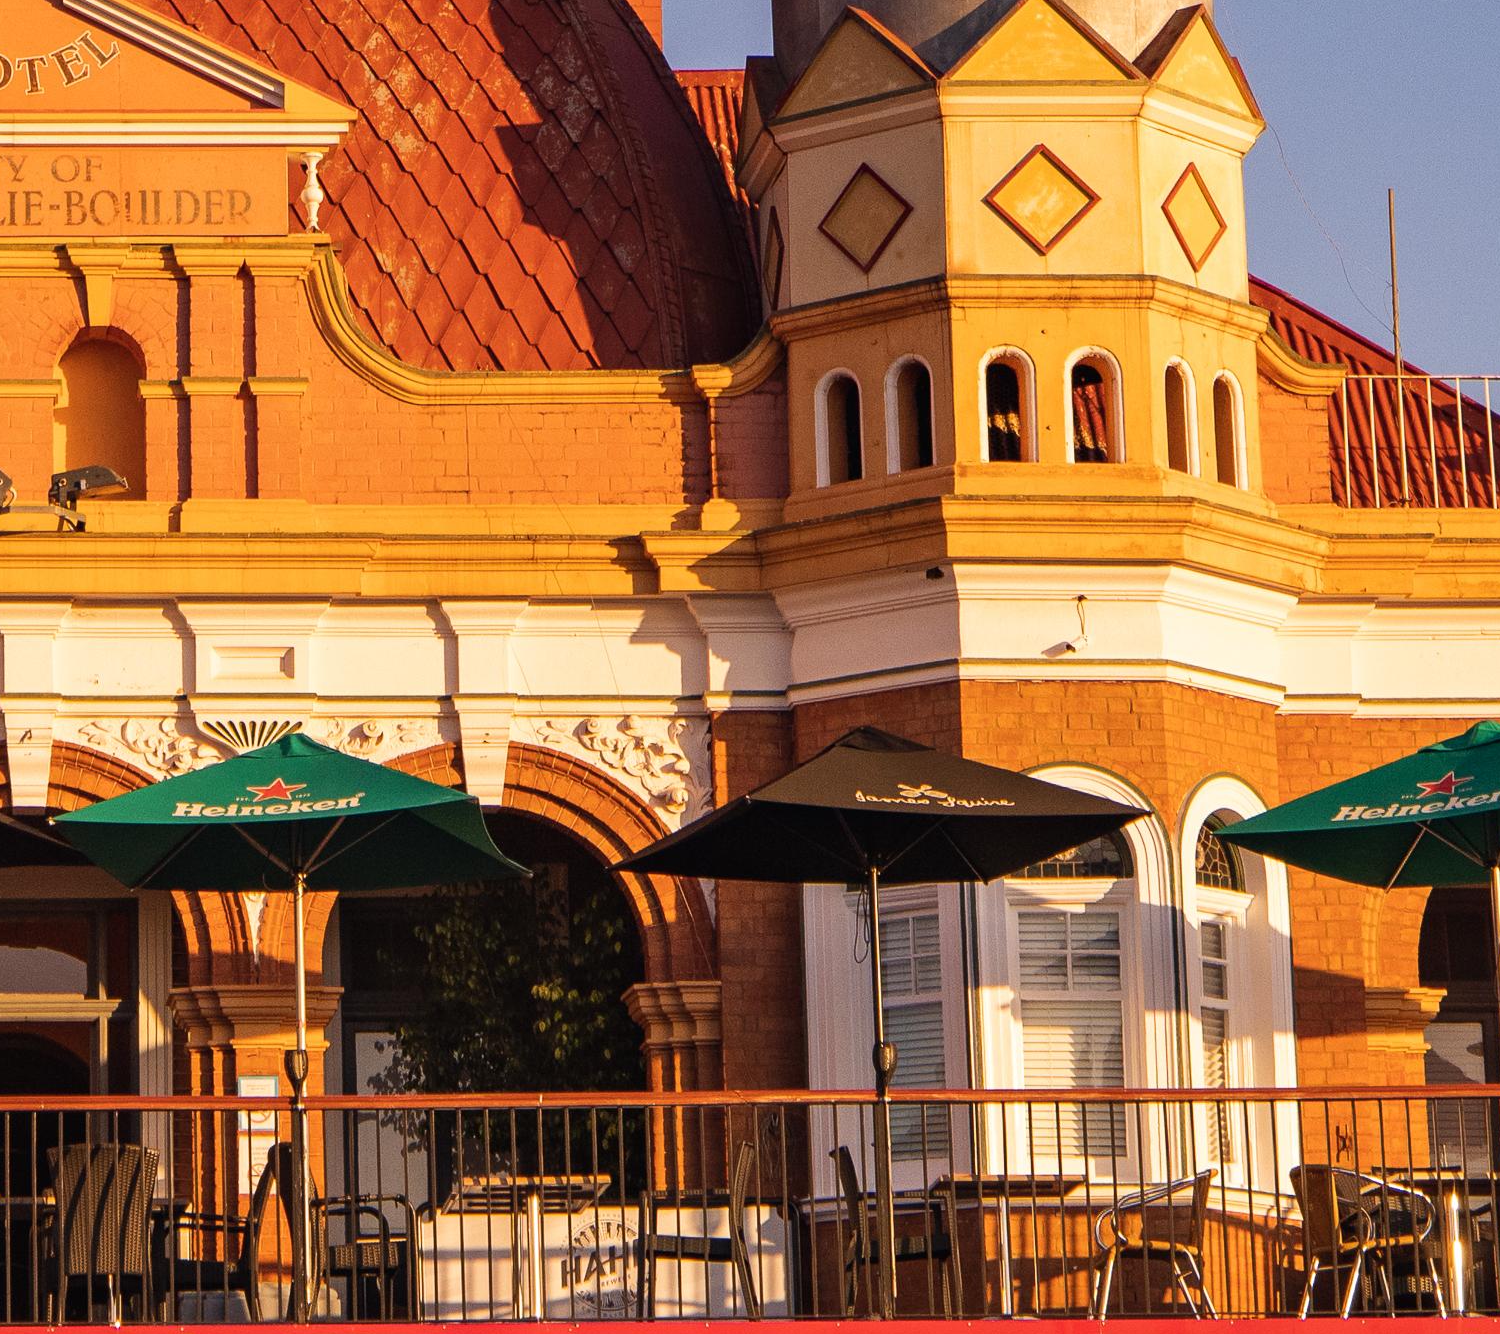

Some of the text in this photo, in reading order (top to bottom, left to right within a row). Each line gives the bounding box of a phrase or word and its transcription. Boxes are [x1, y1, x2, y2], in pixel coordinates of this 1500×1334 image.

[50, 154, 104, 183] OF
[171, 796, 361, 818] Heineken
[855, 790, 1016, 809] James Squire
